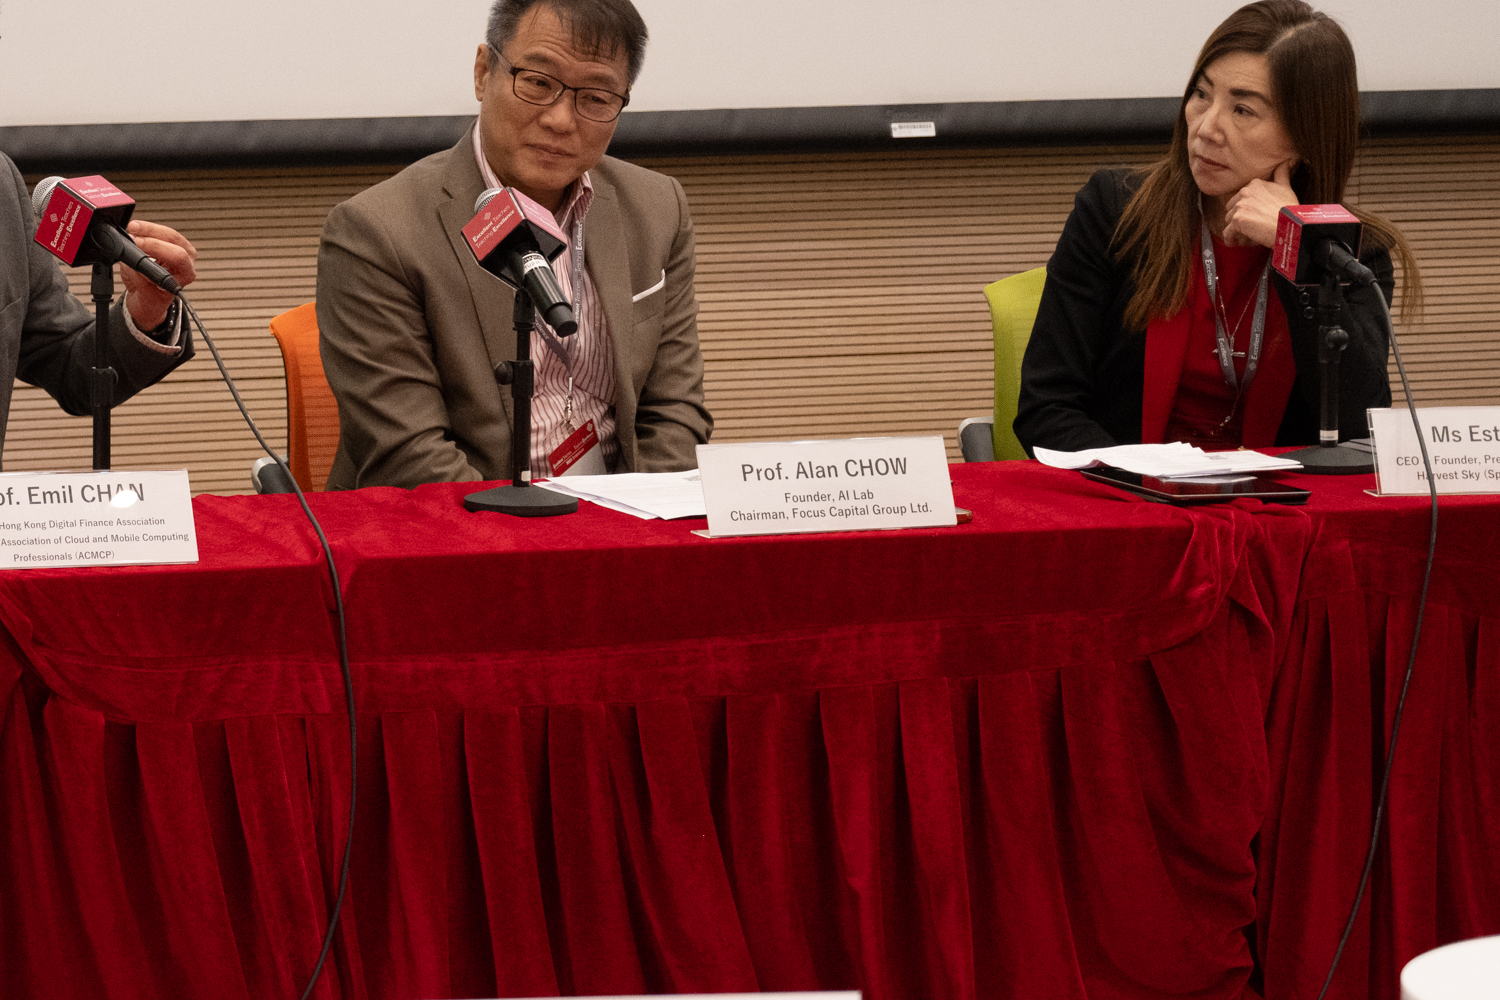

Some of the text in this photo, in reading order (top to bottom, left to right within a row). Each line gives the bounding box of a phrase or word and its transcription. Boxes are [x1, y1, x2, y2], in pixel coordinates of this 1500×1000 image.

[50, 201, 74, 248] Excellent Teachers
[57, 204, 82, 253] Teaching Excellence
[472, 221, 494, 243] Excellent
[492, 205, 511, 222] Teachers
[475, 231, 494, 248] Teaching
[492, 210, 515, 233] Excellence
[575, 223, 583, 251] Excellence
[1431, 424, 1500, 443] Ms Est
[1396, 455, 1420, 466] CEO
[1434, 454, 1481, 466] Founder,
[1484, 454, 1500, 464] Pre
[742, 458, 906, 482] Prof. Alan CHOW
[1461, 469, 1480, 481] Sky
[1484, 468, 1500, 480] (Sp
[28, 485, 73, 504] Emil
[784, 489, 874, 504] Founder, AI Lab
[730, 502, 932, 523] Chairman, Focus Capital Group Ltd.
[23, 520, 47, 531] Kong
[48, 519, 77, 530] Digital
[79, 518, 114, 528] Finance
[116, 517, 166, 527] Association
[0, 537, 52, 547] Association
[54, 536, 63, 545] of
[64, 535, 90, 545] Cloud
[92, 535, 109, 544] and
[110, 533, 140, 543] Mobile
[142, 532, 190, 544] Computing
[13, 550, 115, 562] Professionals (ACMCP)
